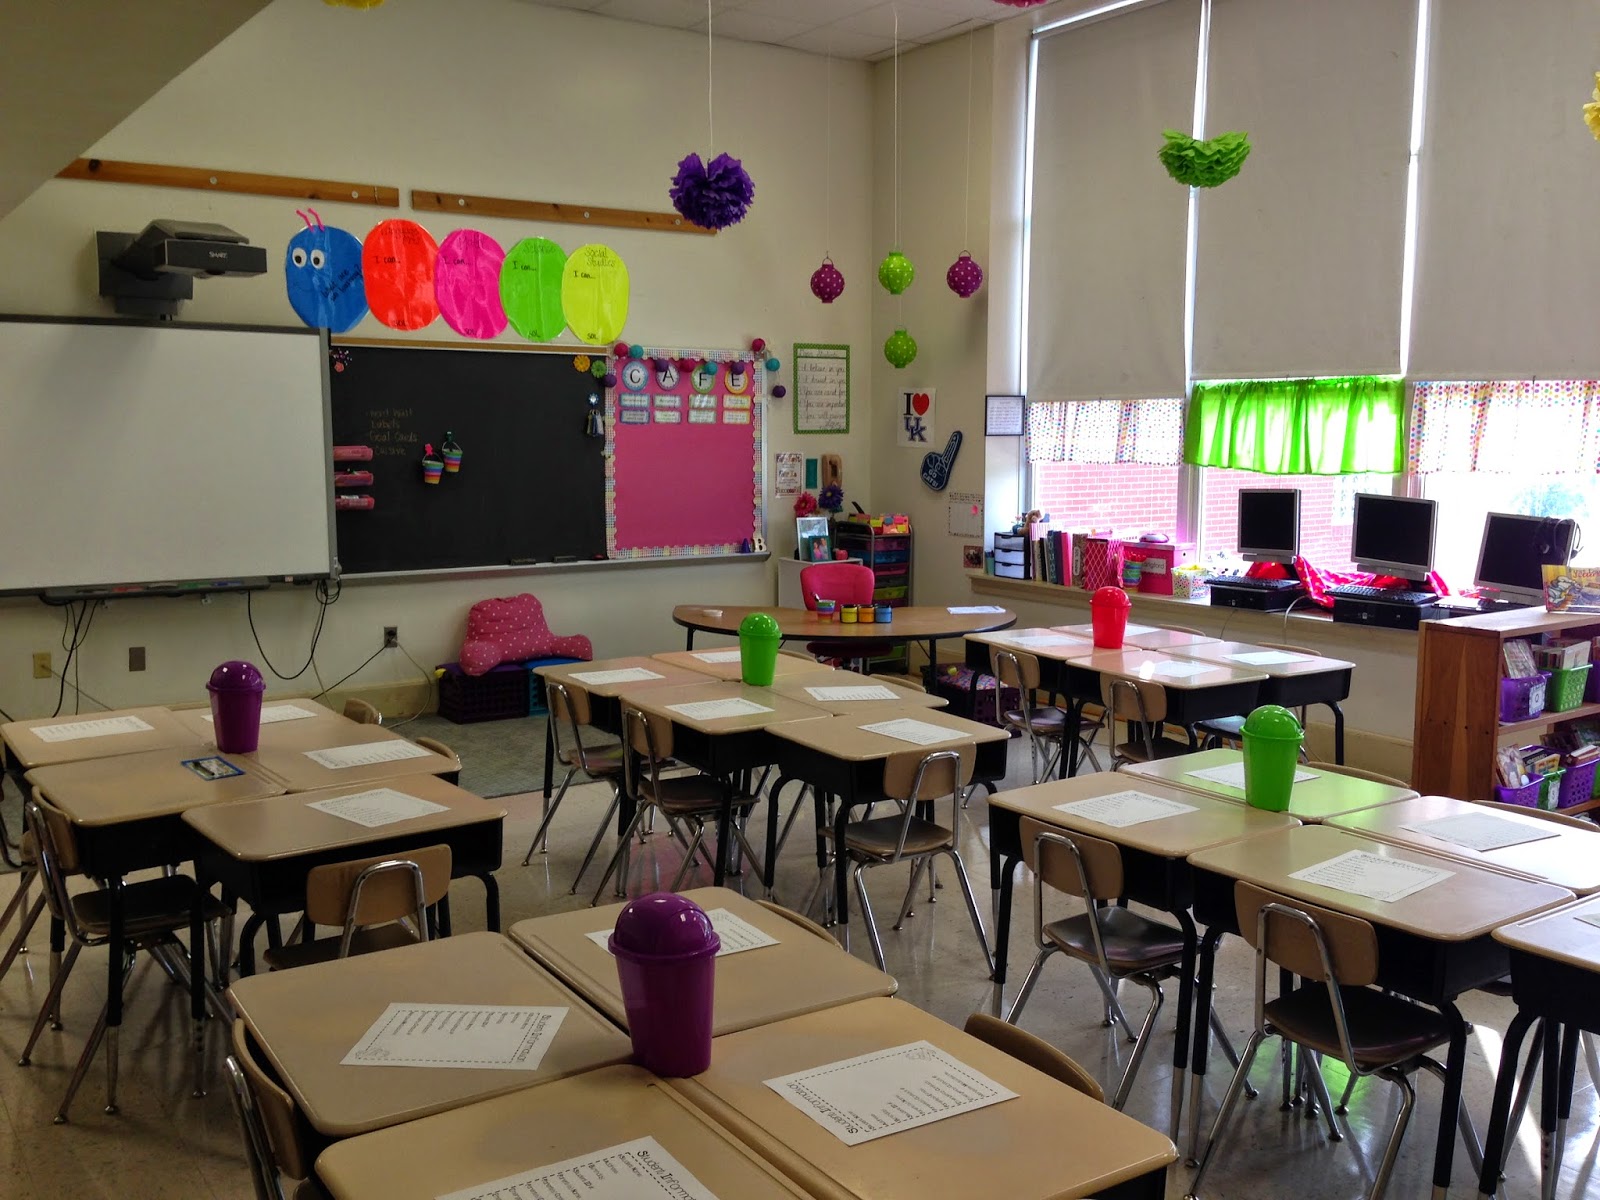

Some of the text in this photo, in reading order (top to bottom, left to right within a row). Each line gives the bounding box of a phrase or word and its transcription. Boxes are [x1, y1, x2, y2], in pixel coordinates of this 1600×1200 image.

[584, 247, 608, 258] Social
[630, 368, 641, 384] C
[903, 392, 914, 416] I
[904, 416, 928, 442] UK
[922, 472, 938, 488] CATS!
[928, 468, 938, 479] GO
[754, 537, 767, 552] B
[786, 1082, 858, 1134] Student Information
[637, 1150, 666, 1175] Student
